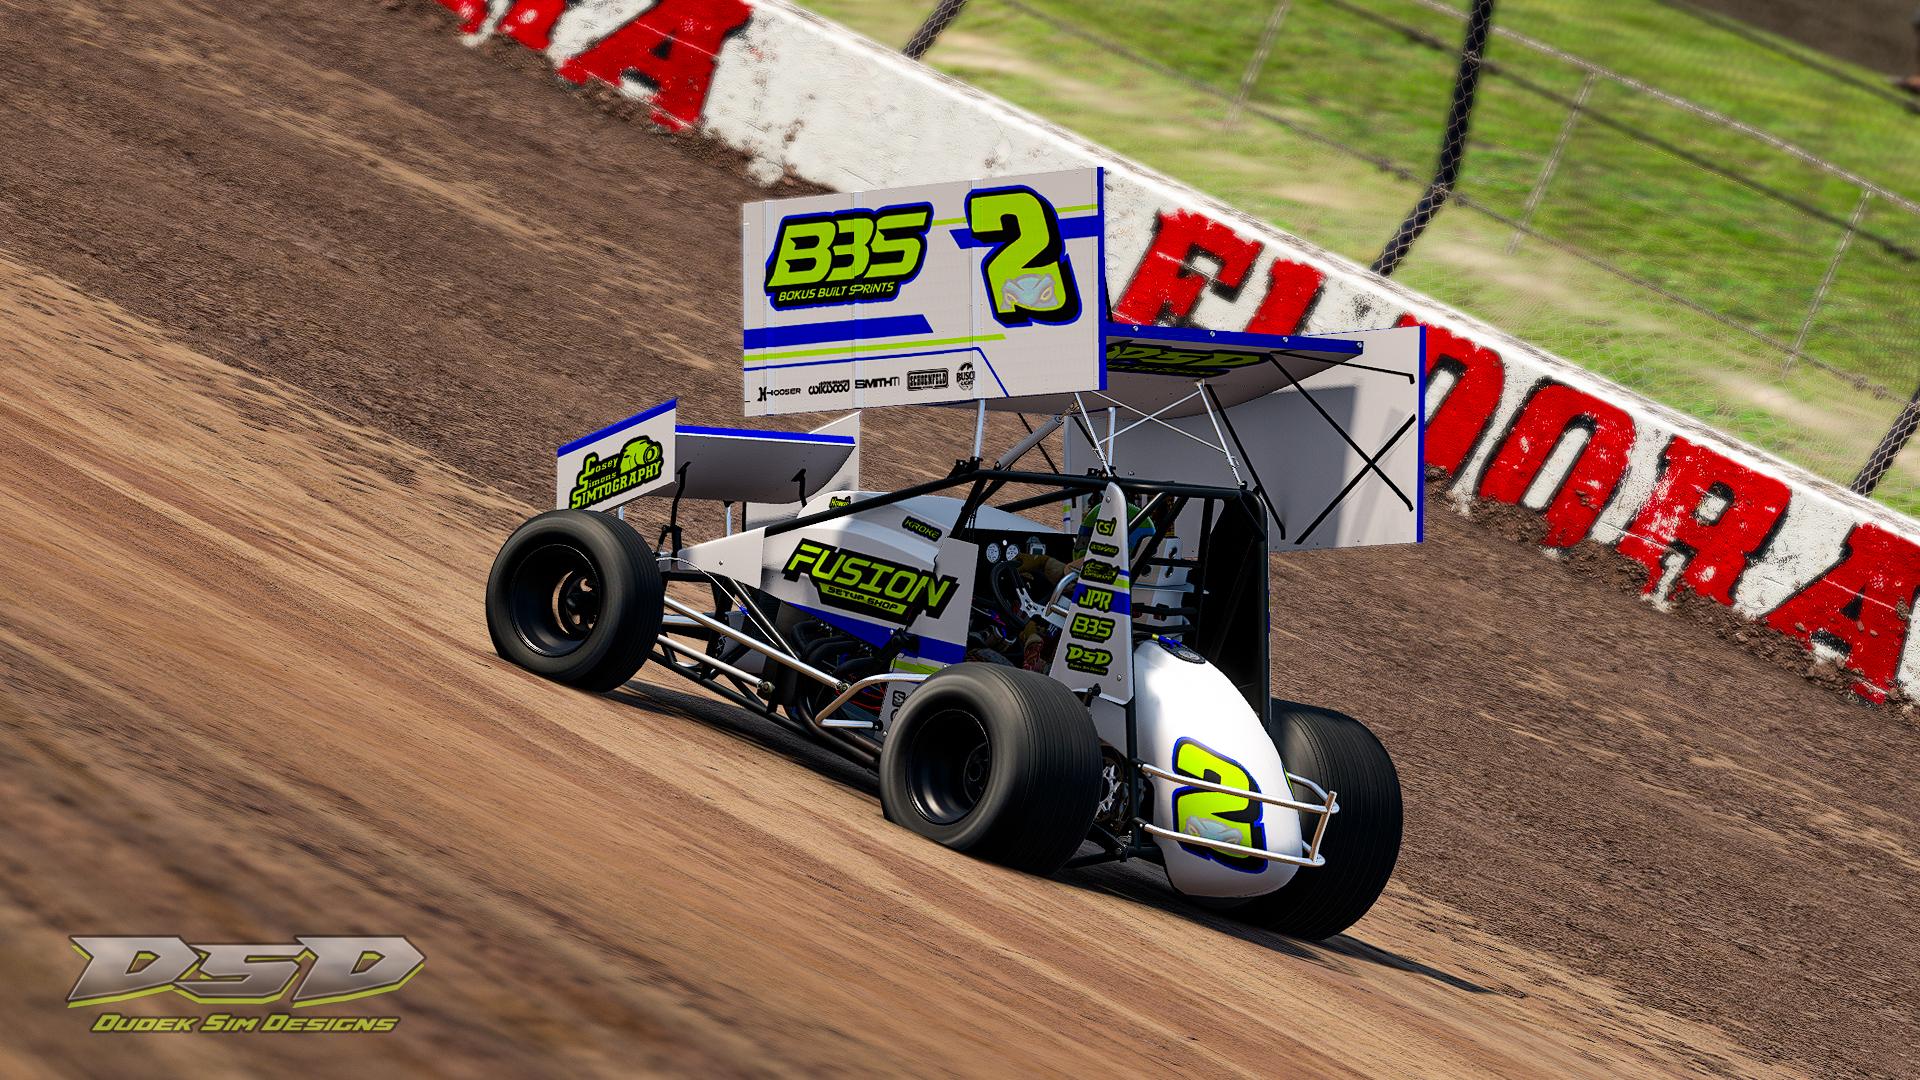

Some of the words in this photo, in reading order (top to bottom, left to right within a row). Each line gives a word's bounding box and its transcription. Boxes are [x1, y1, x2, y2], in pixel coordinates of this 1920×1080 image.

[968, 189, 1074, 320] 2
[778, 288, 816, 302] BOKUS
[904, 518, 940, 539] KROKE
[787, 543, 951, 608] FUSION
[826, 586, 865, 601] SETUP
[866, 595, 899, 611] SHOP
[1079, 588, 1112, 611] JPR
[1175, 740, 1258, 864] 2
